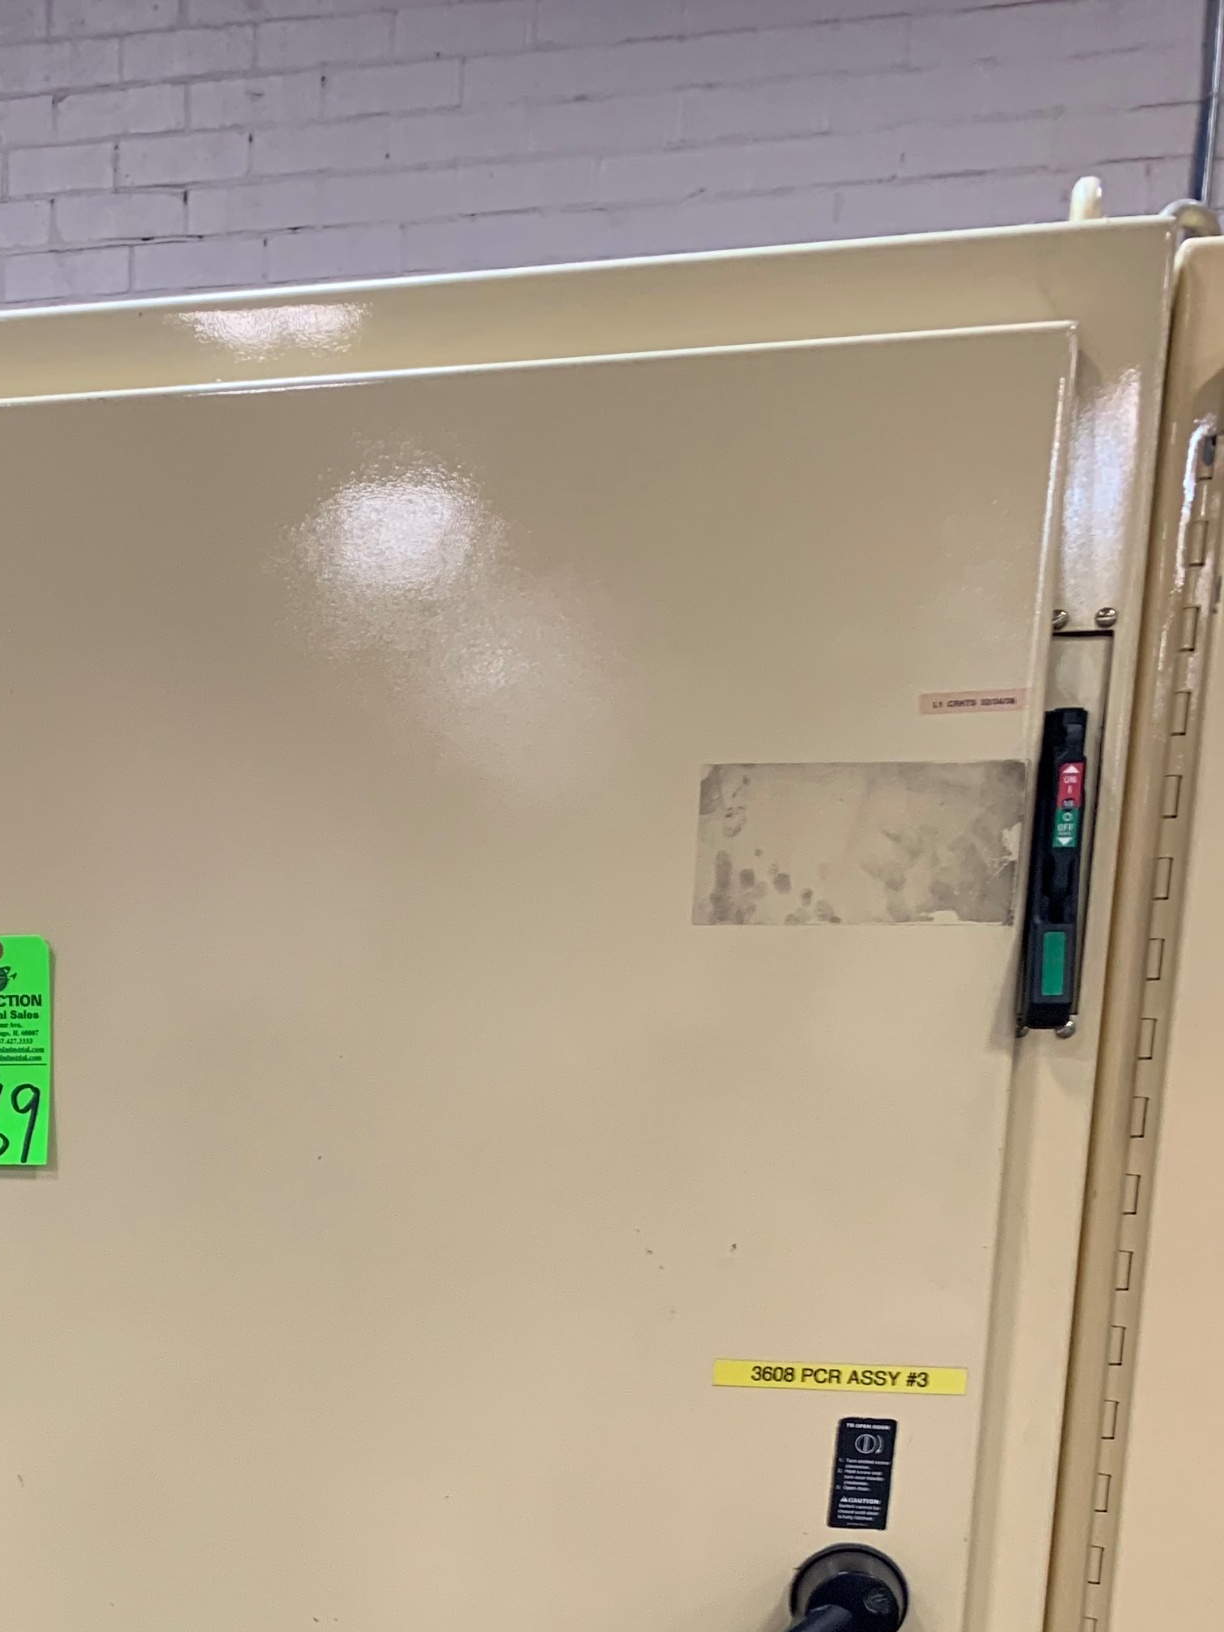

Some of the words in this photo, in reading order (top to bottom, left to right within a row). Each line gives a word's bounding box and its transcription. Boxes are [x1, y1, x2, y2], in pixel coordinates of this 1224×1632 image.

[1057, 823, 1075, 832] OFF
[10, 1010, 39, 1019] Sales
[751, 1365, 795, 1383] 3608
[800, 1367, 841, 1385] PCR
[846, 1369, 901, 1387] ASSY
[905, 1371, 930, 1388] #3
